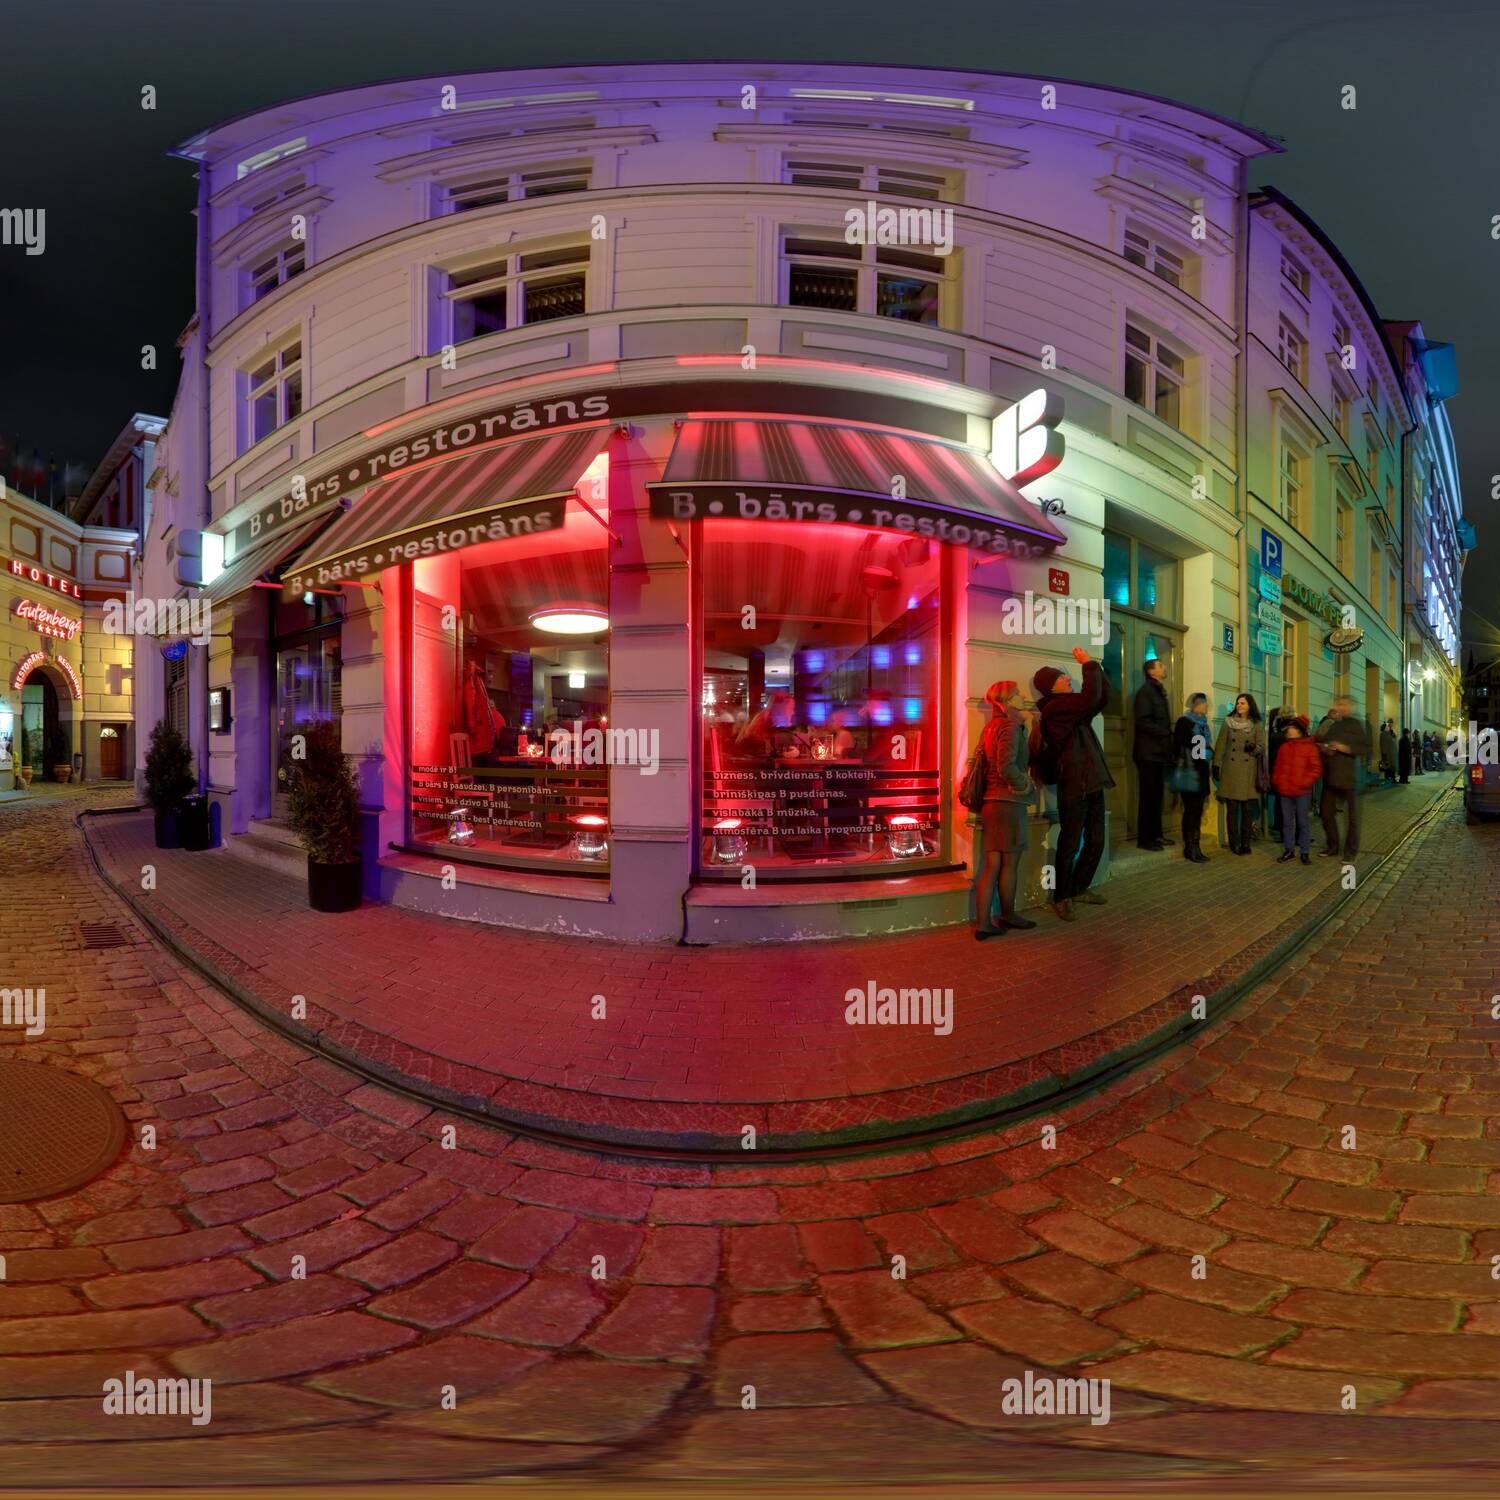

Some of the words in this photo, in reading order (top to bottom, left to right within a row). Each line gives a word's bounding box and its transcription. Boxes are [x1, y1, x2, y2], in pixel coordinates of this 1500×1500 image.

[249, 517, 262, 537] B
[367, 395, 610, 477] restorāns
[669, 493, 697, 519] B
[735, 493, 837, 523] bārs
[871, 506, 1046, 561] restorāns
[291, 576, 304, 596] B
[317, 552, 370, 585] bārs
[388, 510, 553, 564] restorāns
[1266, 535, 1278, 567] P
[13, 560, 81, 598] HOTEL
[16, 599, 82, 640] Gutenbergs
[826, 771, 833, 779] B
[779, 790, 787, 798] B
[767, 808, 774, 817] B
[772, 827, 779, 835] B
[781, 827, 796, 835] un
[798, 826, 822, 834] laika
[824, 825, 873, 835] prognoze
